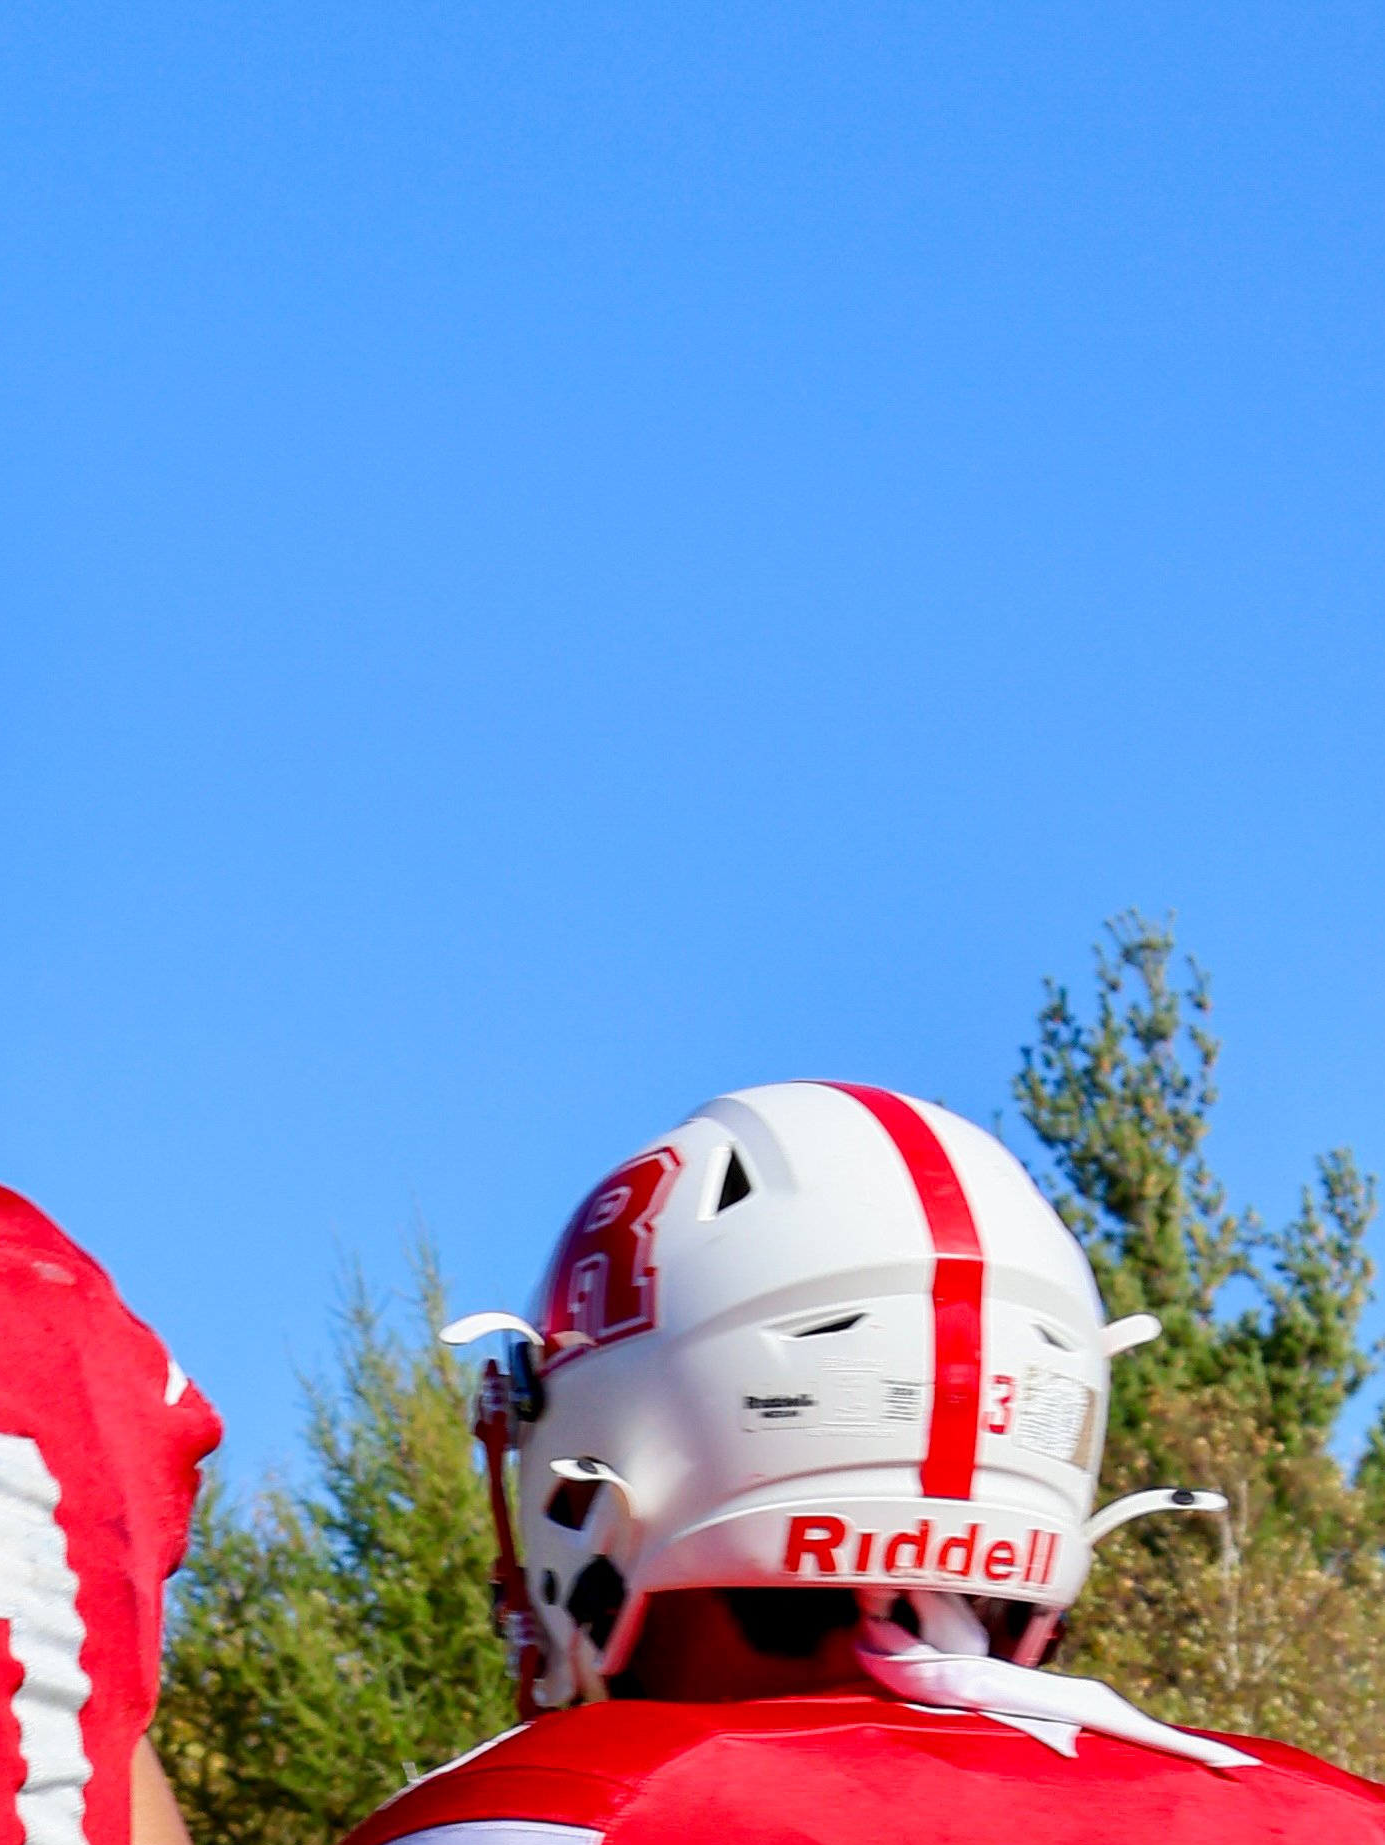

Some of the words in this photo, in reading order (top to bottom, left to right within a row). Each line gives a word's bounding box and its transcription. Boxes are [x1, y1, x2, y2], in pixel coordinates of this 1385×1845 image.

[535, 1147, 683, 1378] R
[980, 1374, 1015, 1435] 3
[782, 1514, 1059, 1589] Riddell
